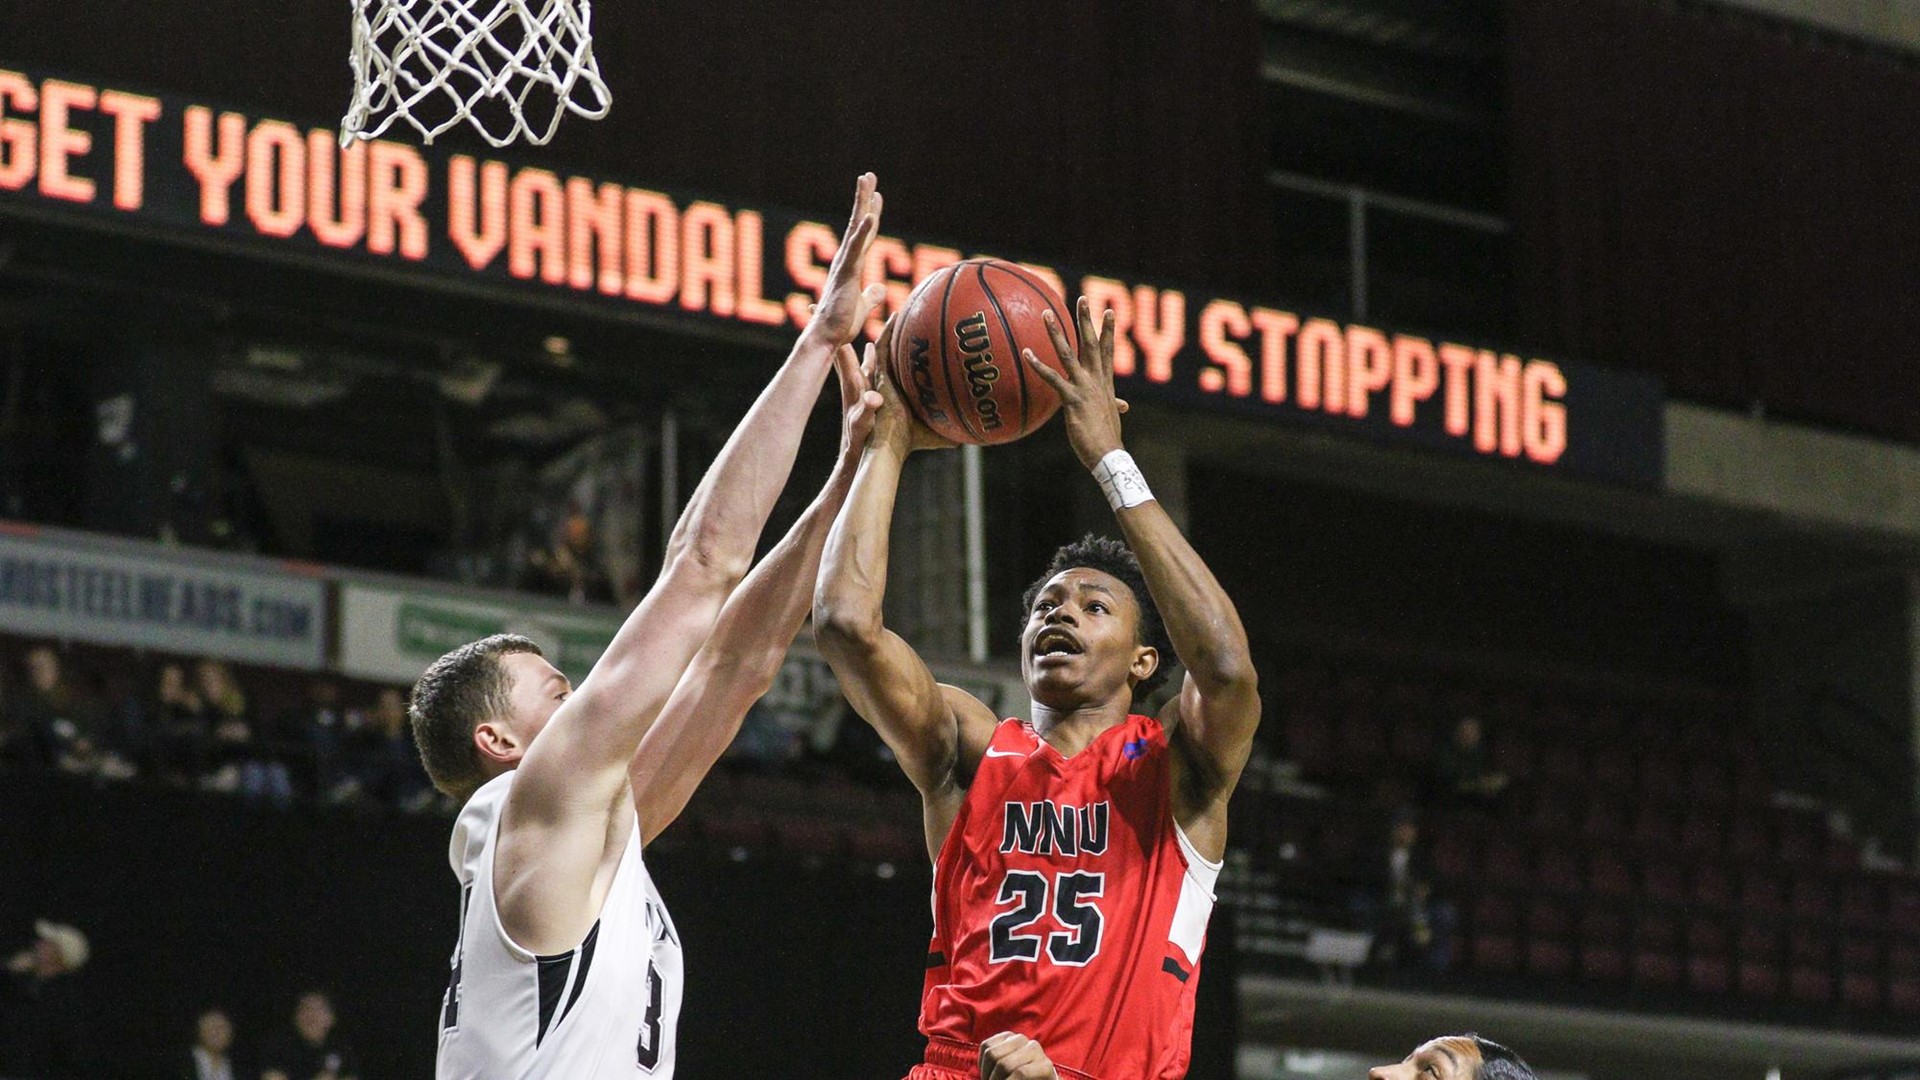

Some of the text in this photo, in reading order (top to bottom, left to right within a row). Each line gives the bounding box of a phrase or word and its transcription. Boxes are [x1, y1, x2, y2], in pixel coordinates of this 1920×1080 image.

[0, 70, 161, 210] GET
[183, 106, 428, 260] YOUR
[954, 311, 1003, 432] Wilson
[1000, 799, 1109, 857] NNU
[988, 869, 1105, 967] 25
